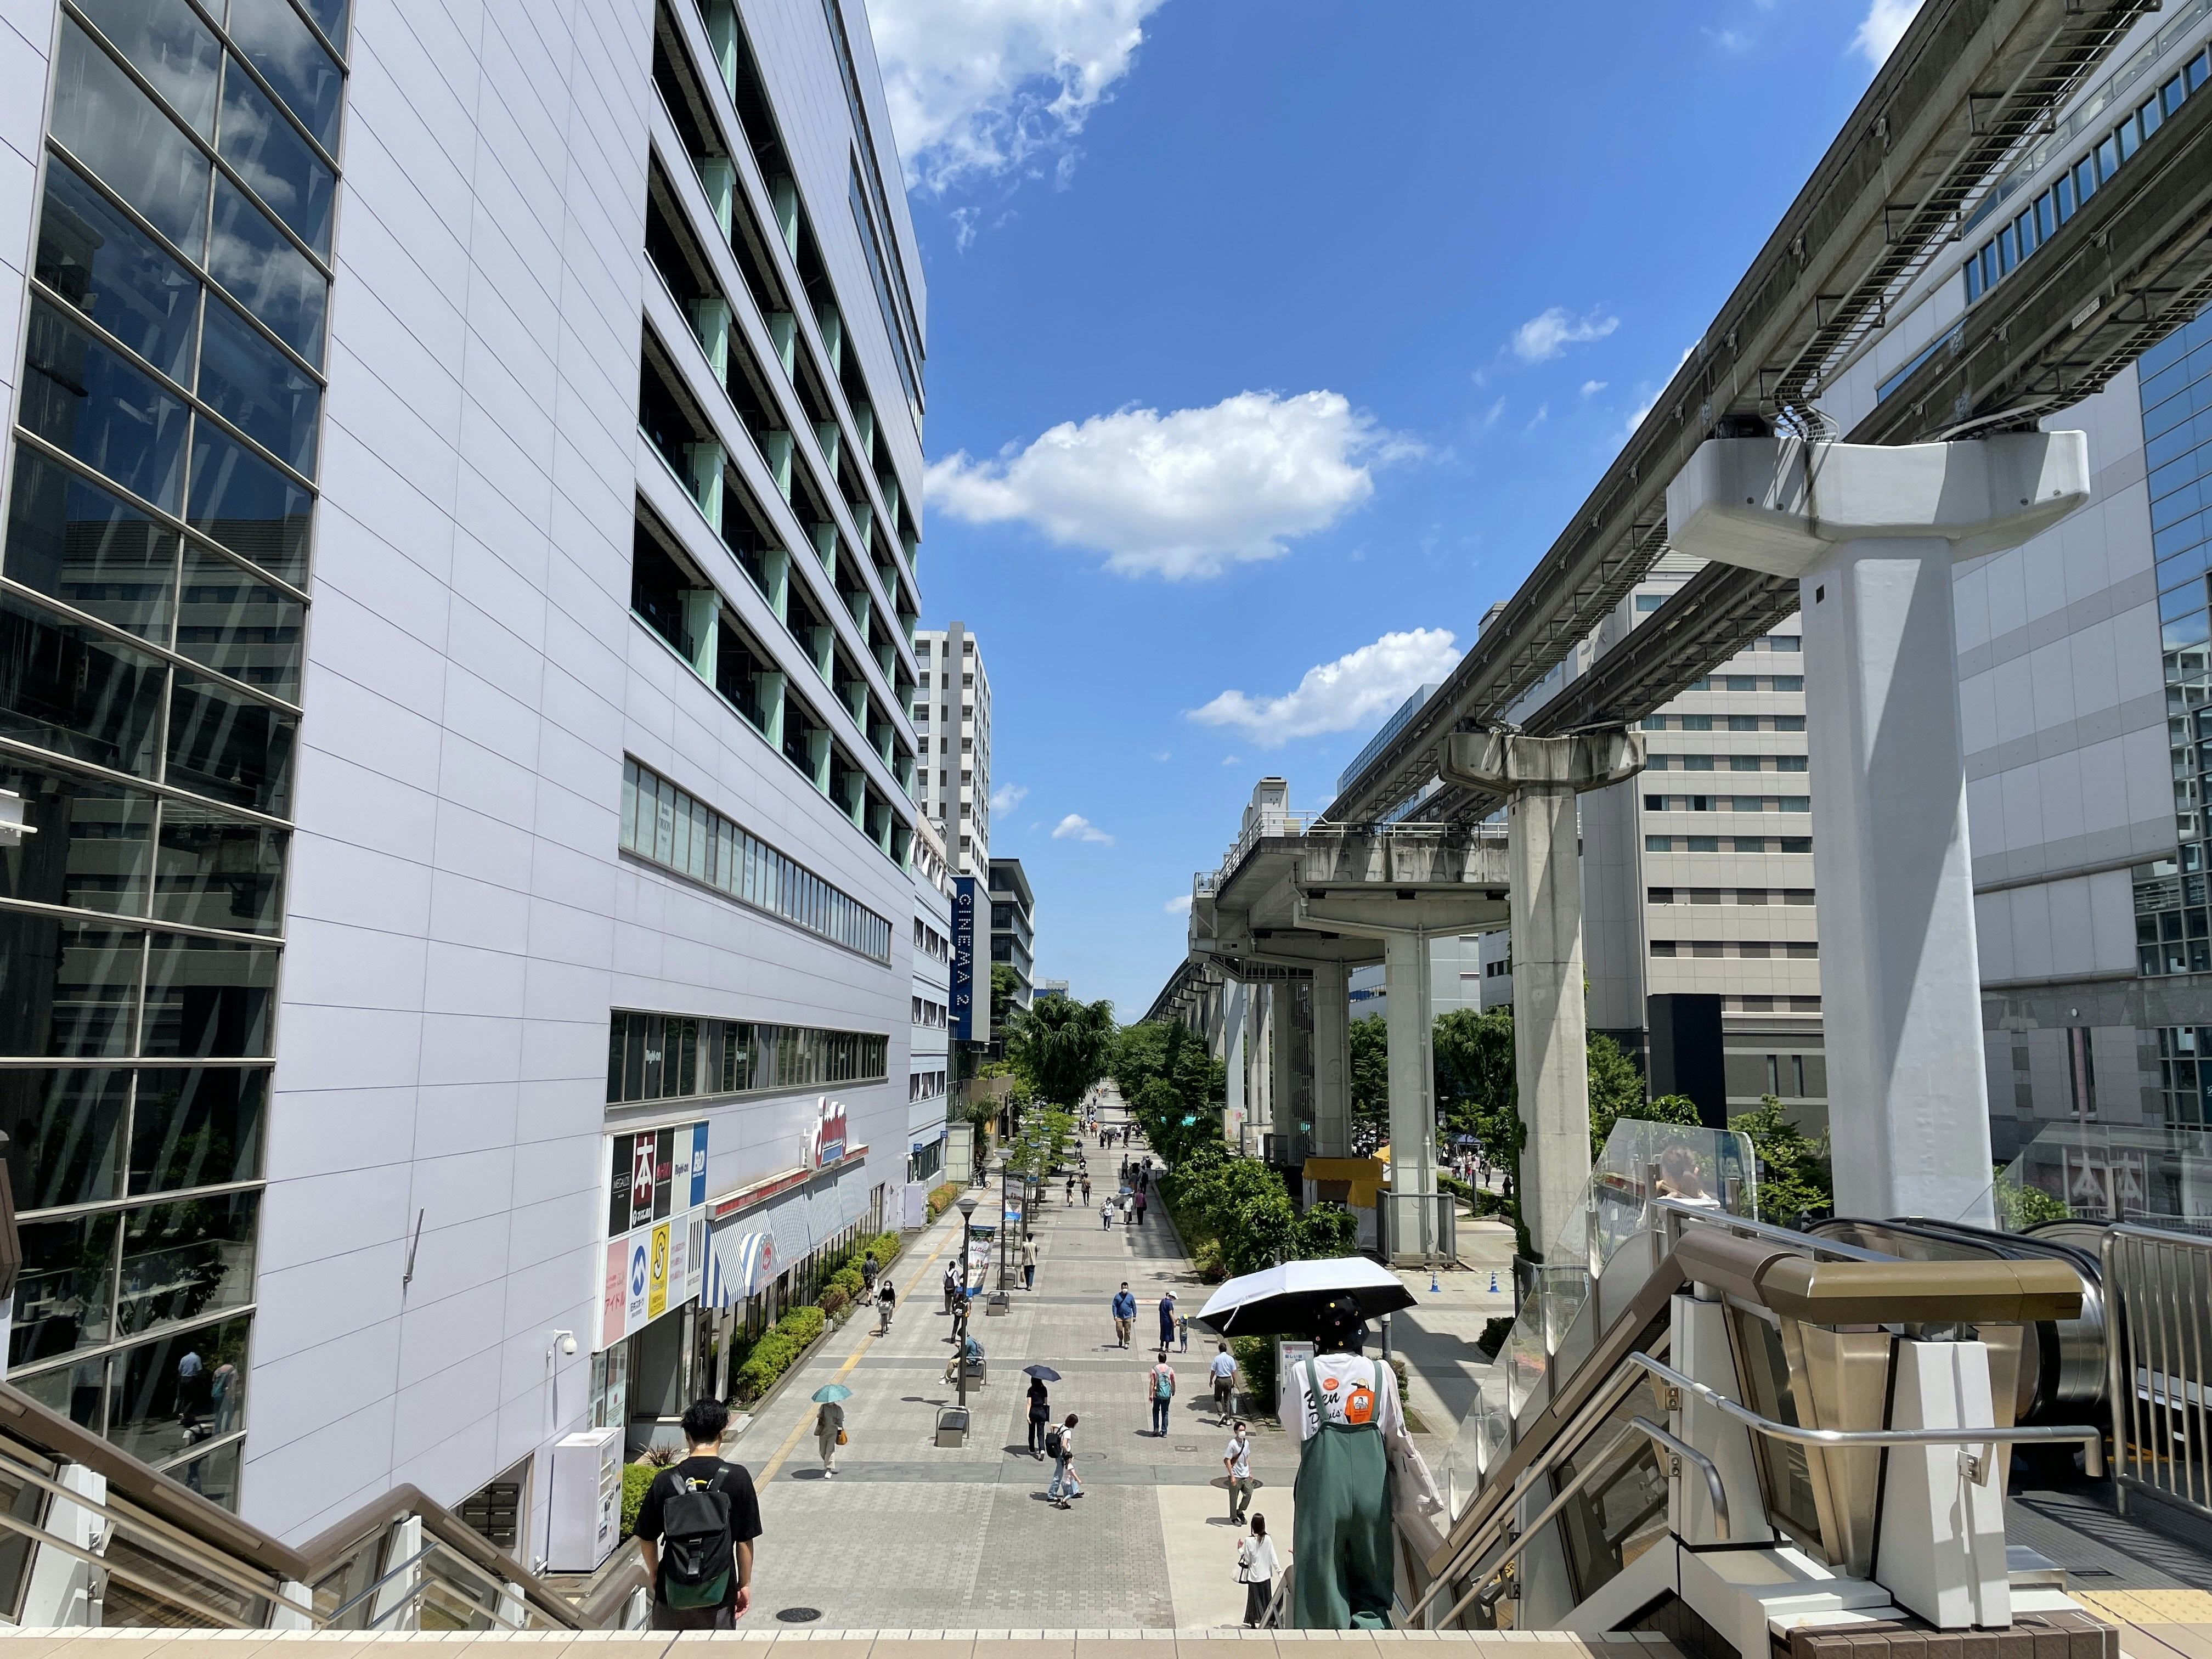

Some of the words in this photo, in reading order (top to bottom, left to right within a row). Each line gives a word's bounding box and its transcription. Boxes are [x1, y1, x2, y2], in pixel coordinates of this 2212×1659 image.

[658, 817, 671, 833] ORION
[957, 894, 972, 984] CINEMA
[956, 994, 969, 1006] 2
[645, 1049, 661, 1064] Right-on
[635, 1136, 653, 1199] 本
[675, 1163, 689, 1177] Right-on
[613, 1176, 630, 1189] MEGALOS
[605, 1290, 625, 1316] アイドル
